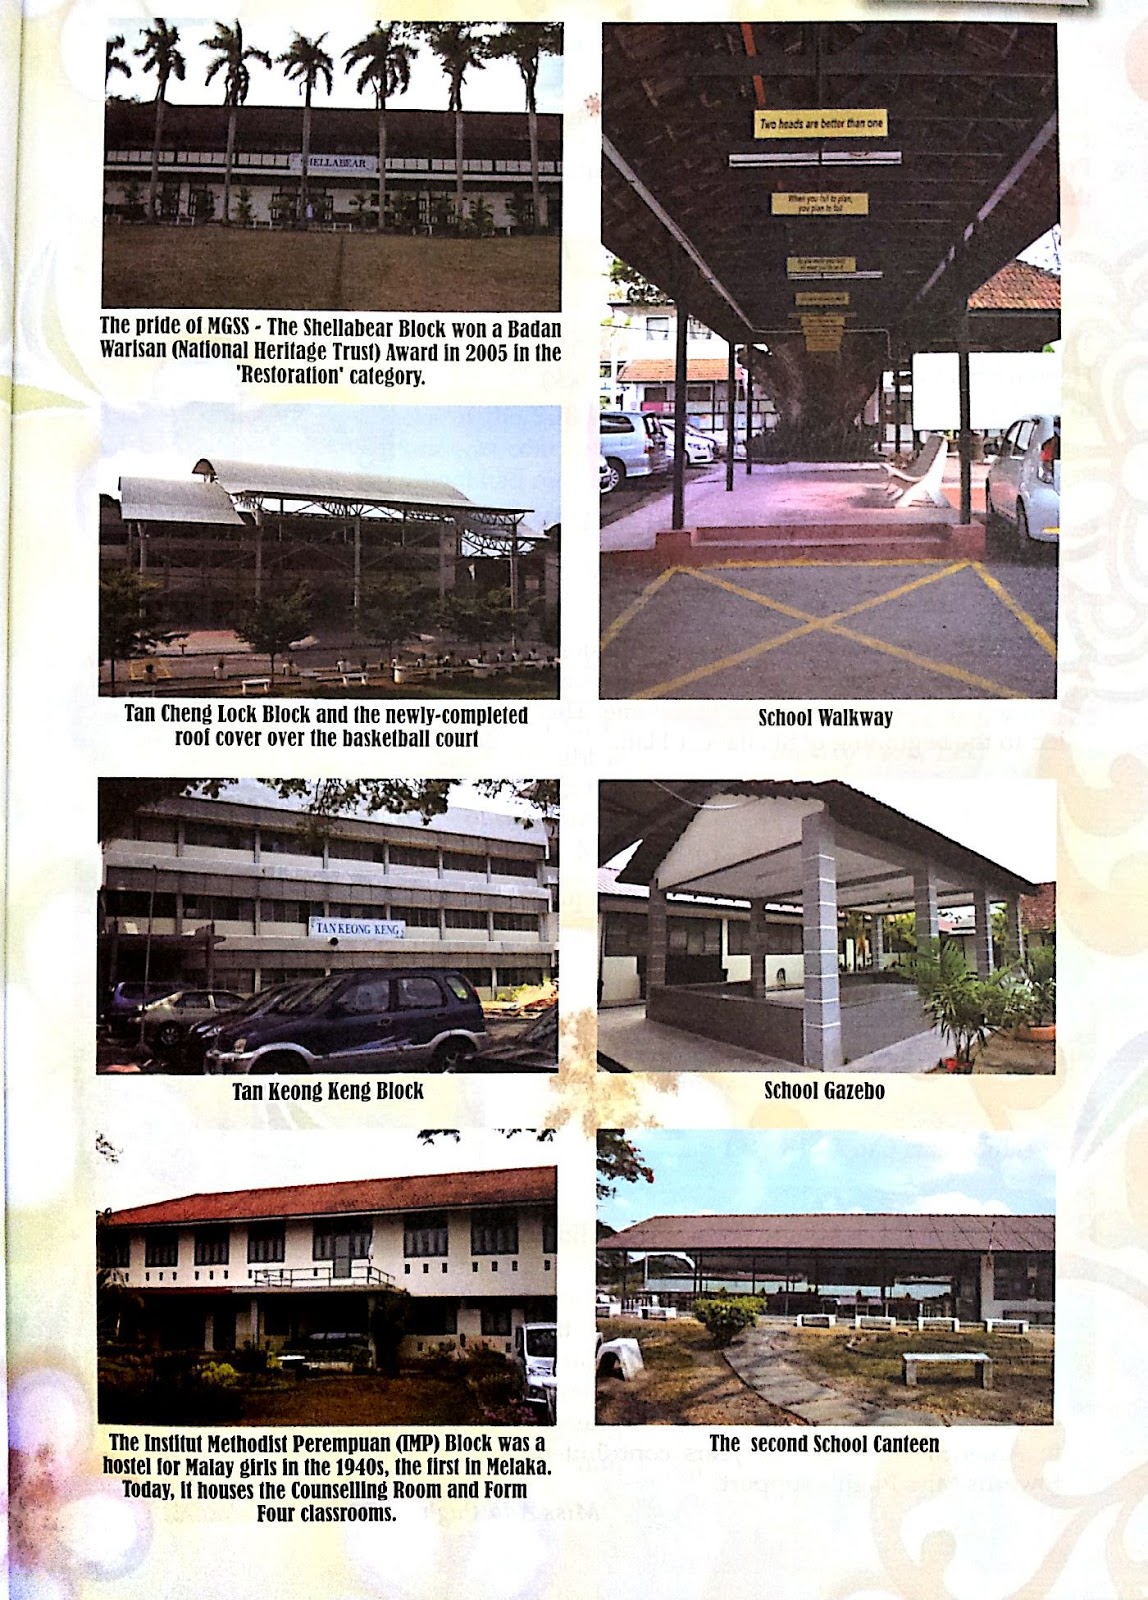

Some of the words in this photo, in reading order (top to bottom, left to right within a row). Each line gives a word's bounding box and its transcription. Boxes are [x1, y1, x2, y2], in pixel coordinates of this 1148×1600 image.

[760, 118, 777, 130] Two
[778, 118, 804, 130] heads
[806, 119, 819, 129] are
[820, 118, 845, 129] better
[847, 118, 866, 129] than
[867, 119, 884, 129] one
[99, 315, 130, 334] The
[135, 315, 181, 337] pride
[185, 316, 203, 335] of
[207, 316, 250, 335] MGSS
[266, 317, 298, 336] The
[303, 317, 394, 338] Shellabear
[398, 319, 447, 338] Block
[451, 322, 489, 338] won
[492, 322, 503, 338] a
[507, 320, 562, 339] Badan
[99, 338, 167, 358] Warisan
[171, 339, 249, 360] (National
[254, 341, 327, 363] Heritage
[332, 342, 381, 364] Trust)
[385, 343, 438, 362] Award
[444, 343, 460, 362] in
[465, 343, 508, 362] 2005
[513, 343, 530, 362] in
[535, 343, 562, 362] the
[236, 364, 344, 384] 'Restoration'
[349, 366, 426, 388] category.
[124, 703, 156, 722] Tan
[161, 703, 213, 725] Cheng
[217, 704, 258, 723] Lock
[262, 704, 311, 724] Block
[316, 705, 348, 724] and
[353, 705, 381, 724] the
[385, 706, 528, 727] newly-completed
[758, 708, 812, 727] School
[817, 708, 894, 729] Walkway
[175, 727, 211, 747] roof
[215, 730, 262, 747] cover
[267, 731, 305, 747] over
[310, 728, 337, 747] the
[342, 729, 430, 748] basketball
[435, 729, 479, 748] court
[316, 922, 336, 934] TAN
[338, 923, 371, 934] KEONG
[374, 924, 399, 935] KENG
[232, 1082, 263, 1101] Tan
[268, 1081, 323, 1103] Keong
[327, 1081, 372, 1102] Keng
[376, 1081, 425, 1100] Block
[764, 1080, 819, 1100] School
[824, 1081, 886, 1100] Gazebo
[108, 1433, 140, 1452] The
[144, 1433, 203, 1453] Institut
[207, 1434, 288, 1453] Methodist
[292, 1434, 391, 1456] Perempuan
[395, 1434, 440, 1455] (IMP)
[444, 1433, 493, 1452] Block
[497, 1436, 530, 1452] was
[535, 1436, 546, 1452] a
[709, 1434, 741, 1452] The
[751, 1434, 809, 1453] second
[813, 1434, 868, 1453] School
[873, 1434, 940, 1453] Canteen
[102, 1455, 152, 1475] hostel
[156, 1457, 181, 1476] for
[185, 1457, 235, 1479] Malay
[239, 1457, 277, 1479] girls
[282, 1457, 299, 1476] in
[304, 1458, 331, 1476] the
[335, 1457, 390, 1478] 1940s,
[394, 1457, 422, 1476] the
[426, 1457, 460, 1476] first
[465, 1457, 482, 1476] in
[486, 1457, 552, 1476] Melaka.
[121, 1479, 175, 1501] Today,
[180, 1480, 193, 1500] it
[197, 1481, 254, 1500] houses
[258, 1481, 286, 1500] the
[291, 1480, 388, 1501] Counselling
[392, 1480, 442, 1499] Room
[447, 1480, 479, 1499] and
[484, 1480, 528, 1499] Form
[257, 1504, 296, 1523] Four
[300, 1503, 397, 1523] classrooms.
